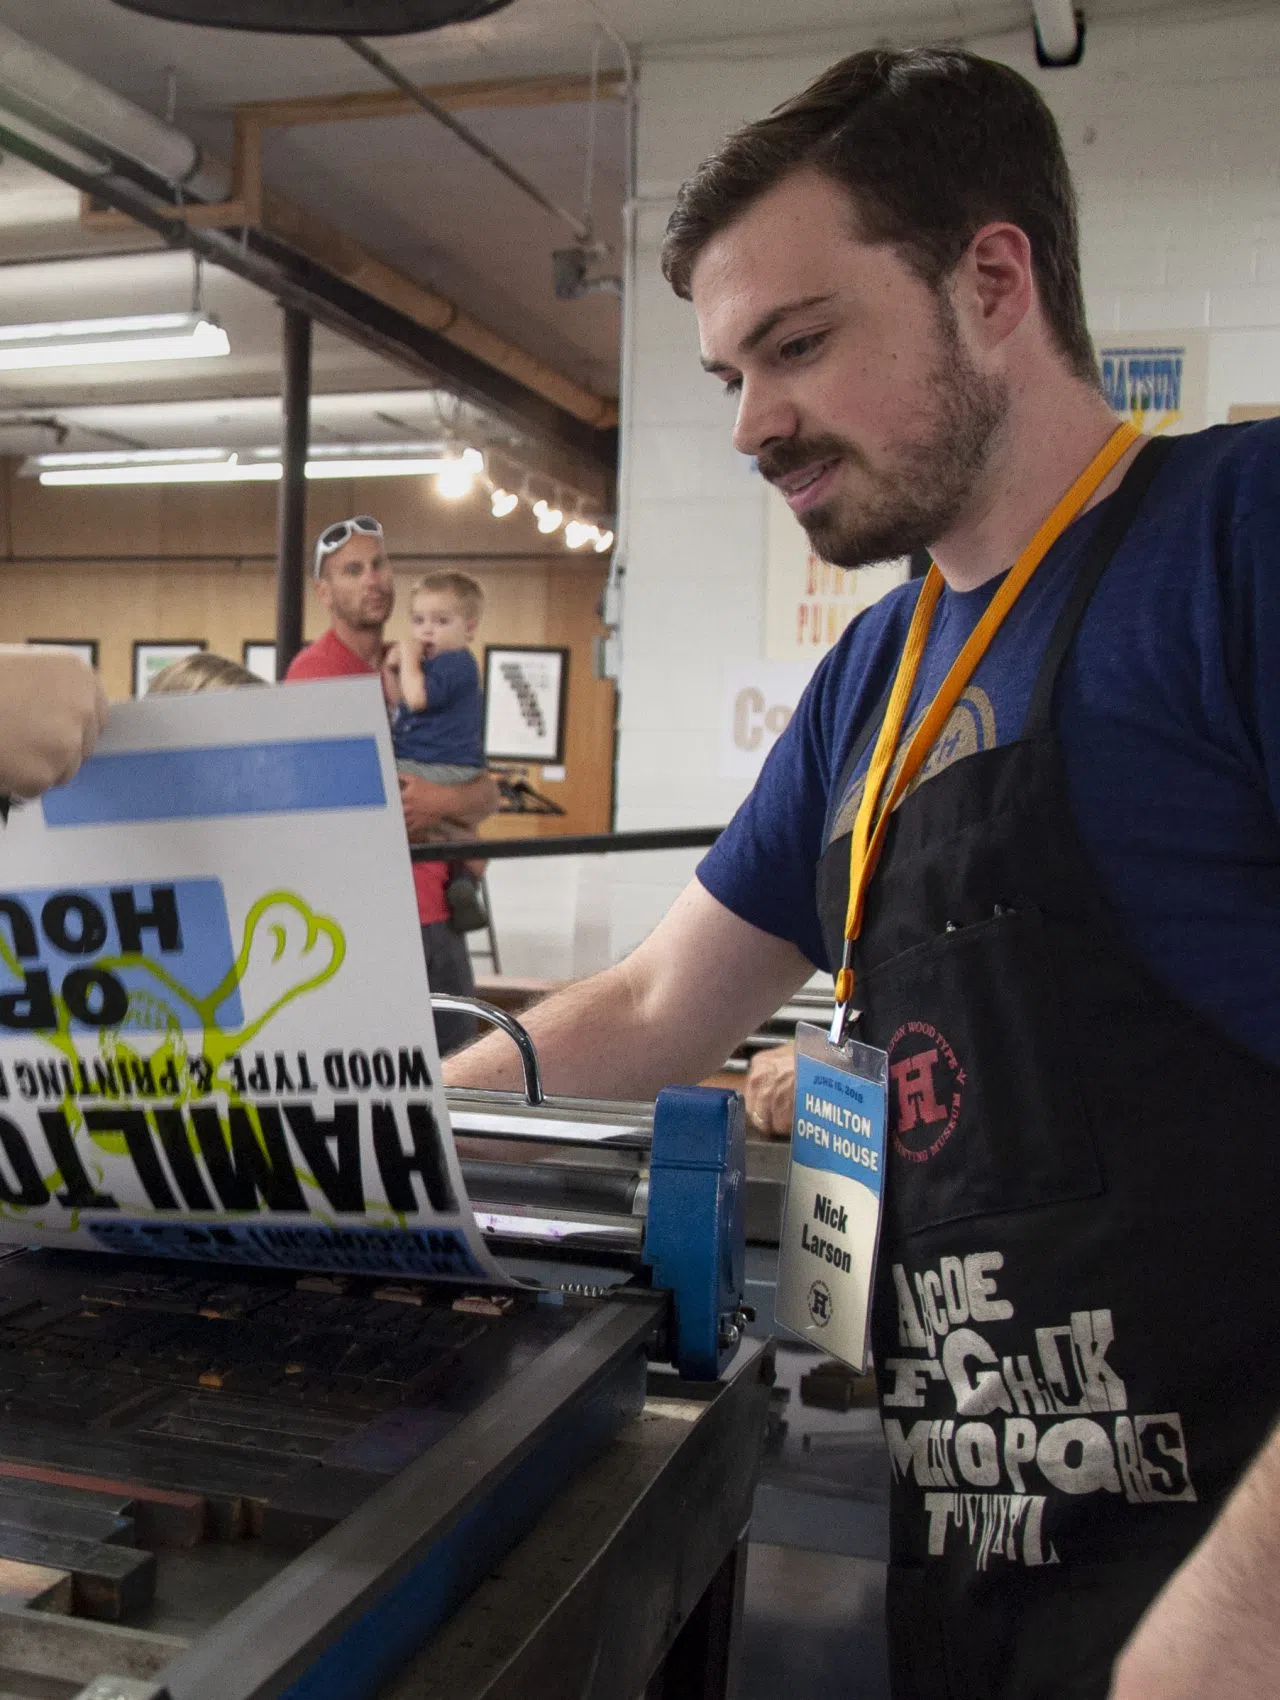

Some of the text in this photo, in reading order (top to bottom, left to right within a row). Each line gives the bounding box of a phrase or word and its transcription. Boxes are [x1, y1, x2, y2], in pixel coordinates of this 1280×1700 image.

[21, 1057, 181, 1099] PRINTING
[189, 1053, 215, 1095] &
[235, 1049, 319, 1095] TYPE
[324, 1045, 433, 1092] WOOD
[805, 1091, 872, 1139] HAMILTON
[797, 1119, 879, 1172] OPEN HOUSE
[813, 1192, 848, 1234] Nick
[801, 1222, 852, 1274] Larson
